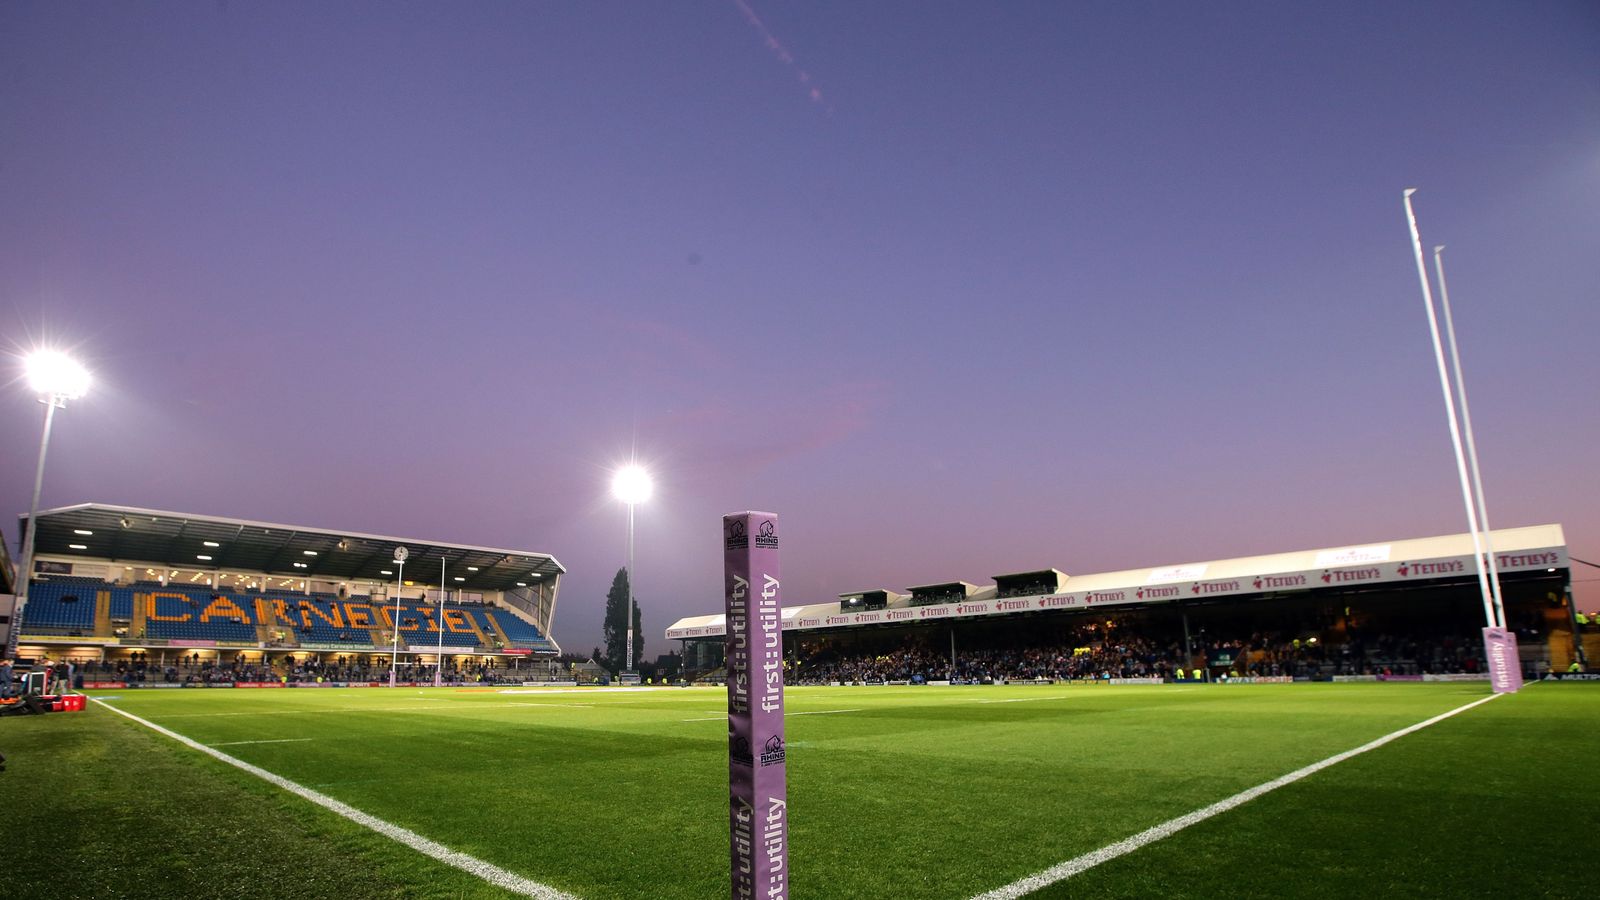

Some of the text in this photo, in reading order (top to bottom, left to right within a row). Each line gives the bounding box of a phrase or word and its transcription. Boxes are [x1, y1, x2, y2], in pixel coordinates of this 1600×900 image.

[1498, 552, 1559, 568] TETLEY'S
[1333, 567, 1381, 581] TETLEY'S
[1410, 560, 1464, 575] TETLEY'S
[1202, 580, 1240, 593] TETLEY'S
[1264, 574, 1307, 588] TETLEY'S
[146, 592, 475, 634] CARNEGIE
[760, 573, 780, 713] first:utility
[760, 752, 785, 762] RHINO
